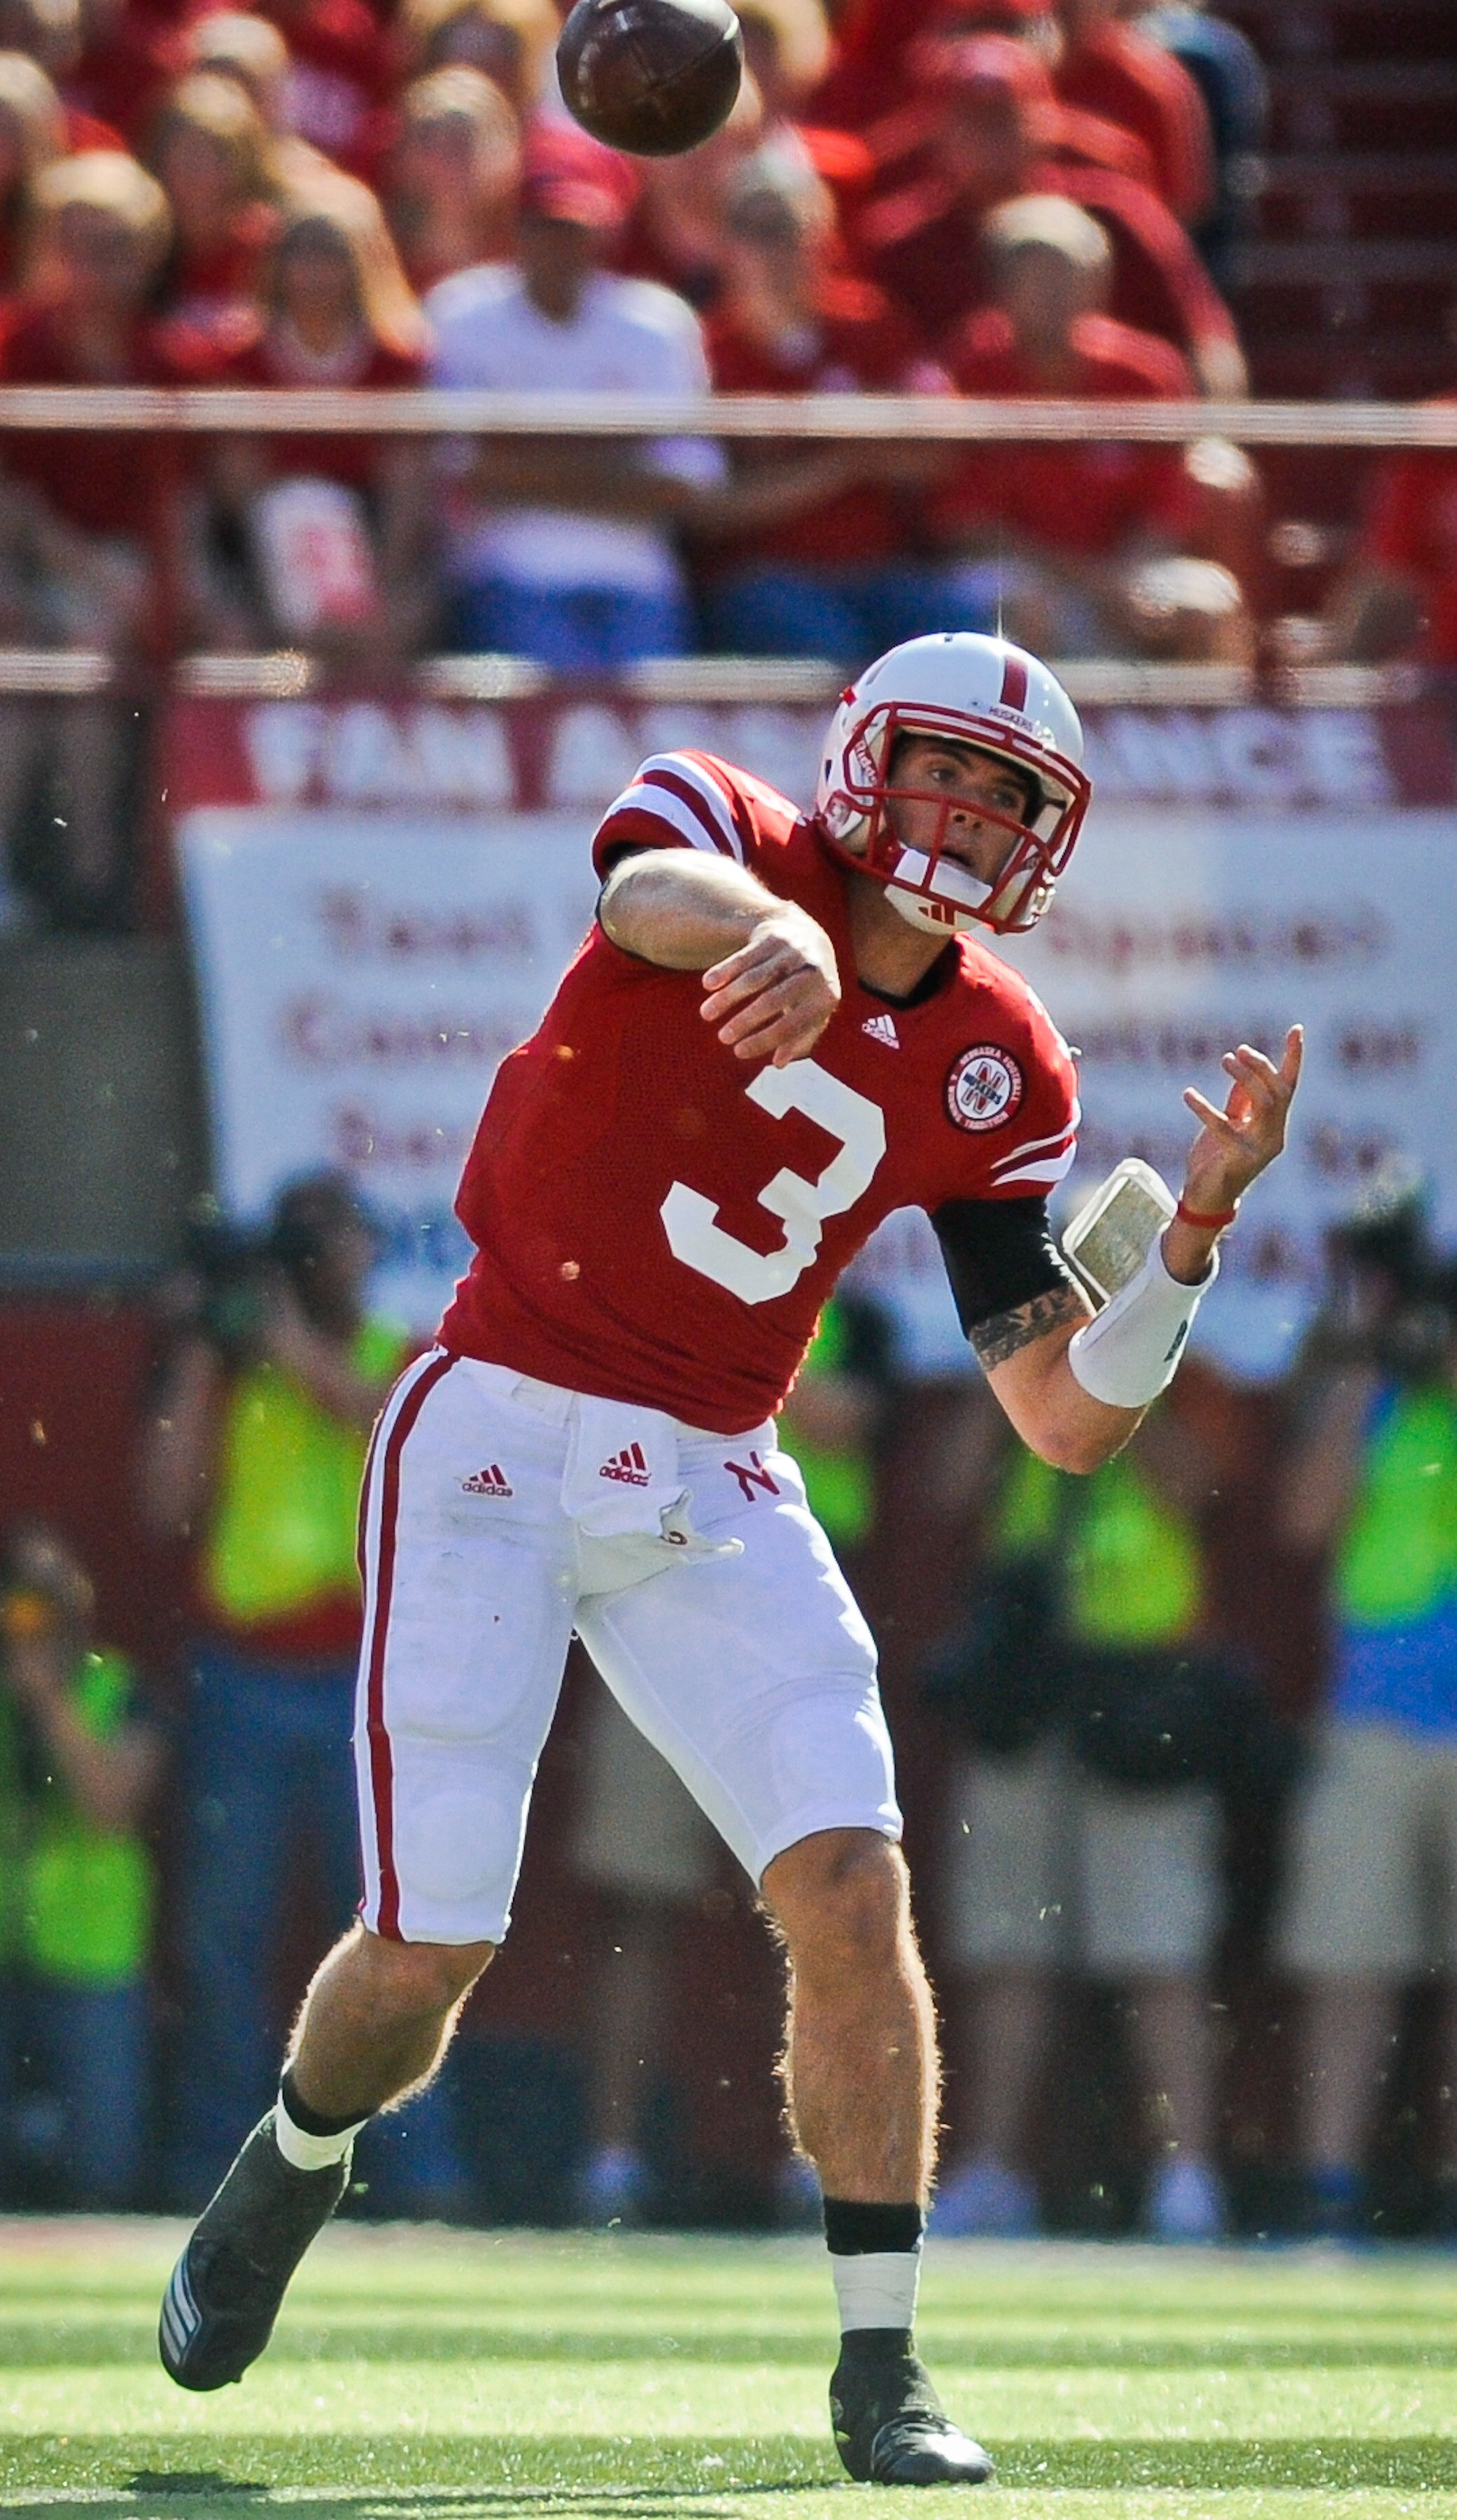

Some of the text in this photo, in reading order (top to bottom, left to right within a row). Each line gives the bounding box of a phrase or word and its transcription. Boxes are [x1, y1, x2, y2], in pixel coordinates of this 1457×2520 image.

[989, 706, 1033, 733] HUSKERS
[246, 702, 516, 799] FAN
[659, 1057, 887, 1306] 3
[462, 1482, 513, 1497] adidas
[723, 1450, 780, 1502] N
